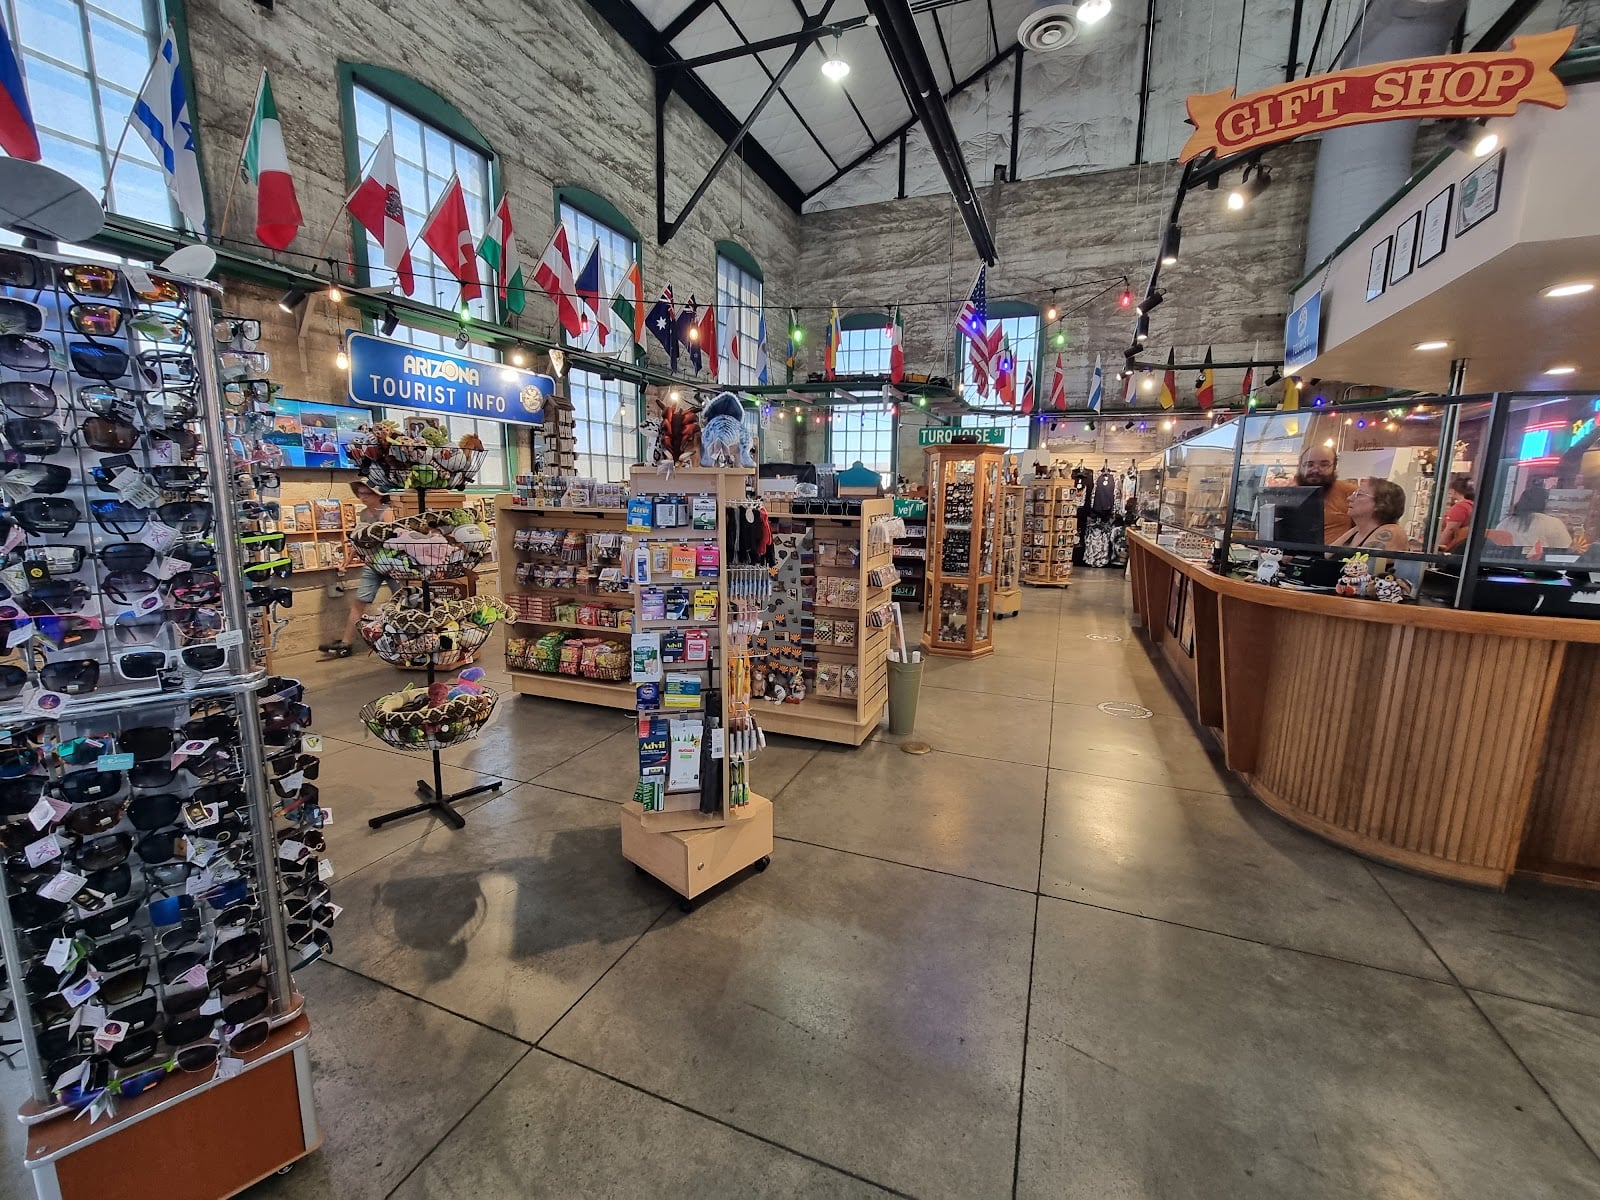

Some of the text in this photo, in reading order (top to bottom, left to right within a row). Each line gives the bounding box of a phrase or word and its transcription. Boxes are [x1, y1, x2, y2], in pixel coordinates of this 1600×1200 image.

[1220, 64, 1526, 138] GIFT SHOP
[403, 354, 480, 386] ARIZONA
[369, 374, 456, 406] TOURIST
[467, 392, 506, 413] INFO
[993, 428, 1004, 436] ST
[897, 503, 914, 517] vey
[641, 741, 666, 750] Advil
